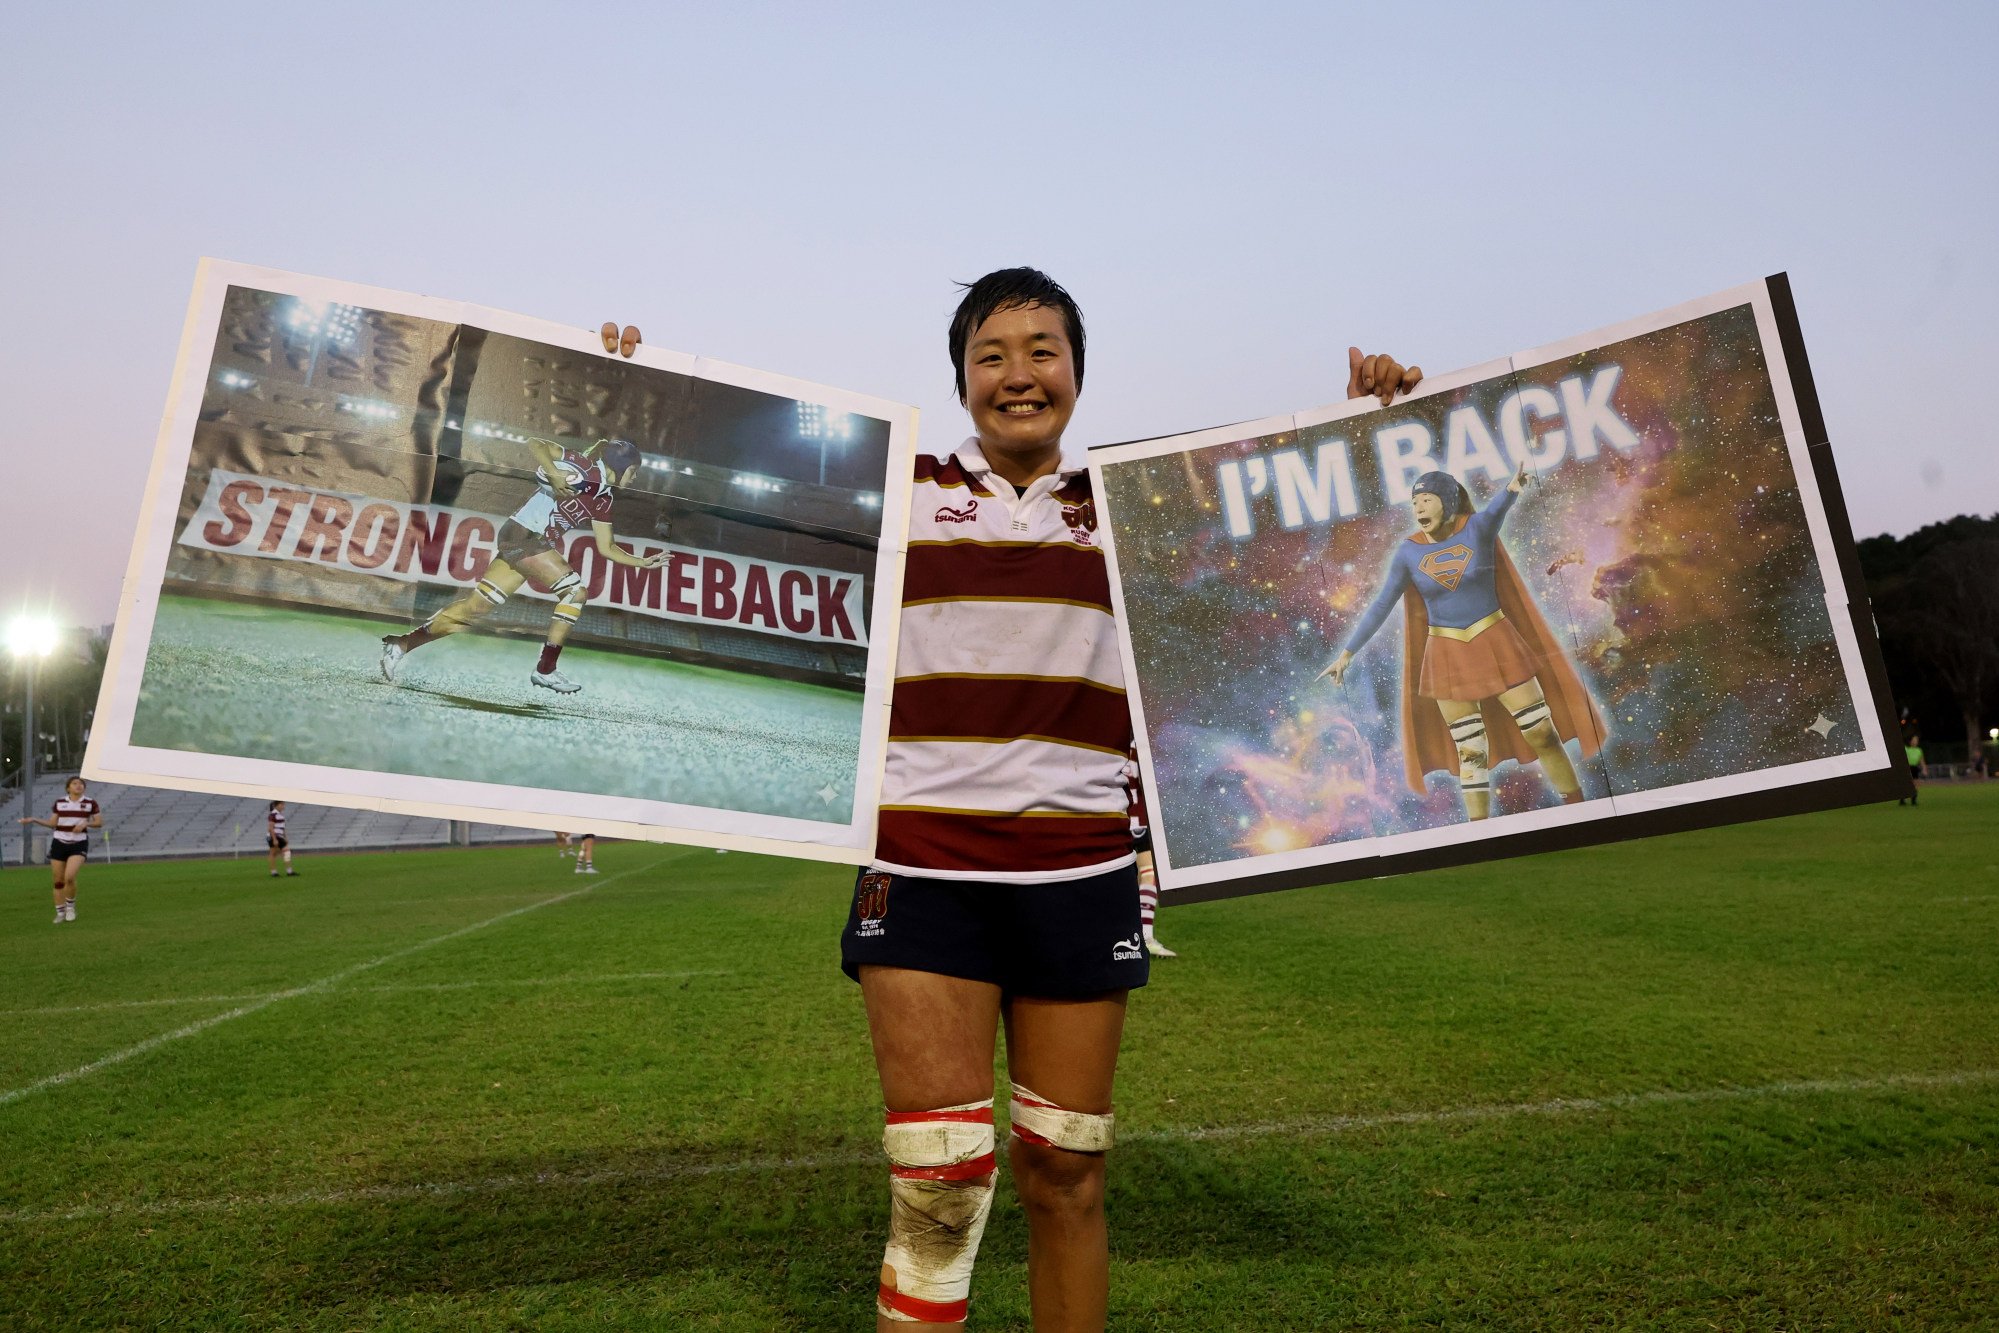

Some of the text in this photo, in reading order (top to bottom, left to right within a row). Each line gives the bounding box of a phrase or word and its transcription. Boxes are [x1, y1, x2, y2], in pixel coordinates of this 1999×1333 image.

[1219, 365, 1640, 538] I'M BACK
[202, 479, 495, 583] STRONG
[934, 513, 977, 524] tsunami
